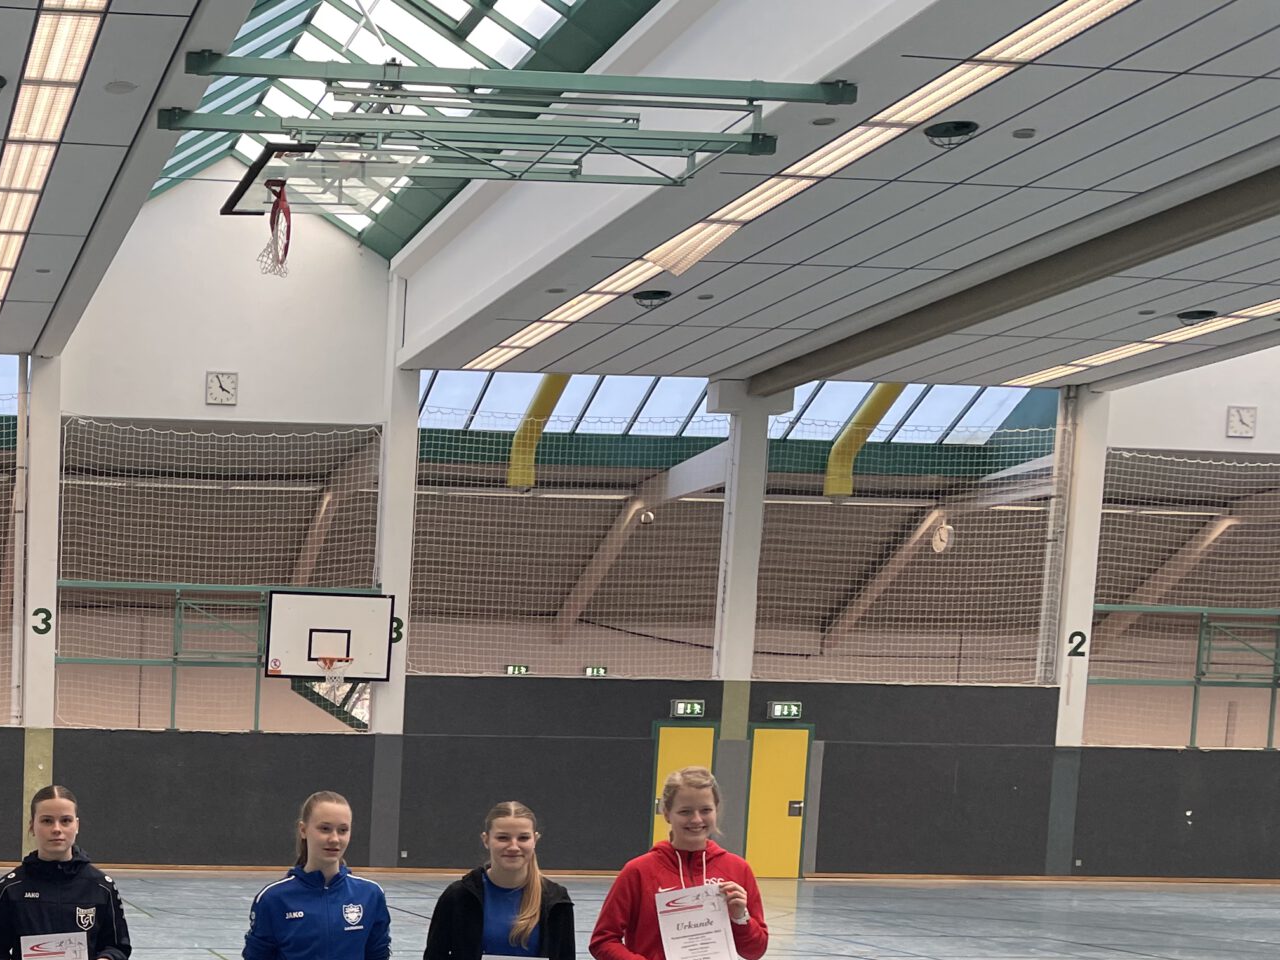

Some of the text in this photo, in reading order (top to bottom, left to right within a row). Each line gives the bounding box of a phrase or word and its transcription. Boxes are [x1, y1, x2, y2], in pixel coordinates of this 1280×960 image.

[32, 607, 52, 635] 3
[1067, 630, 1087, 657] 2
[285, 911, 304, 920] JAKO
[676, 918, 714, 931] Urkunde
